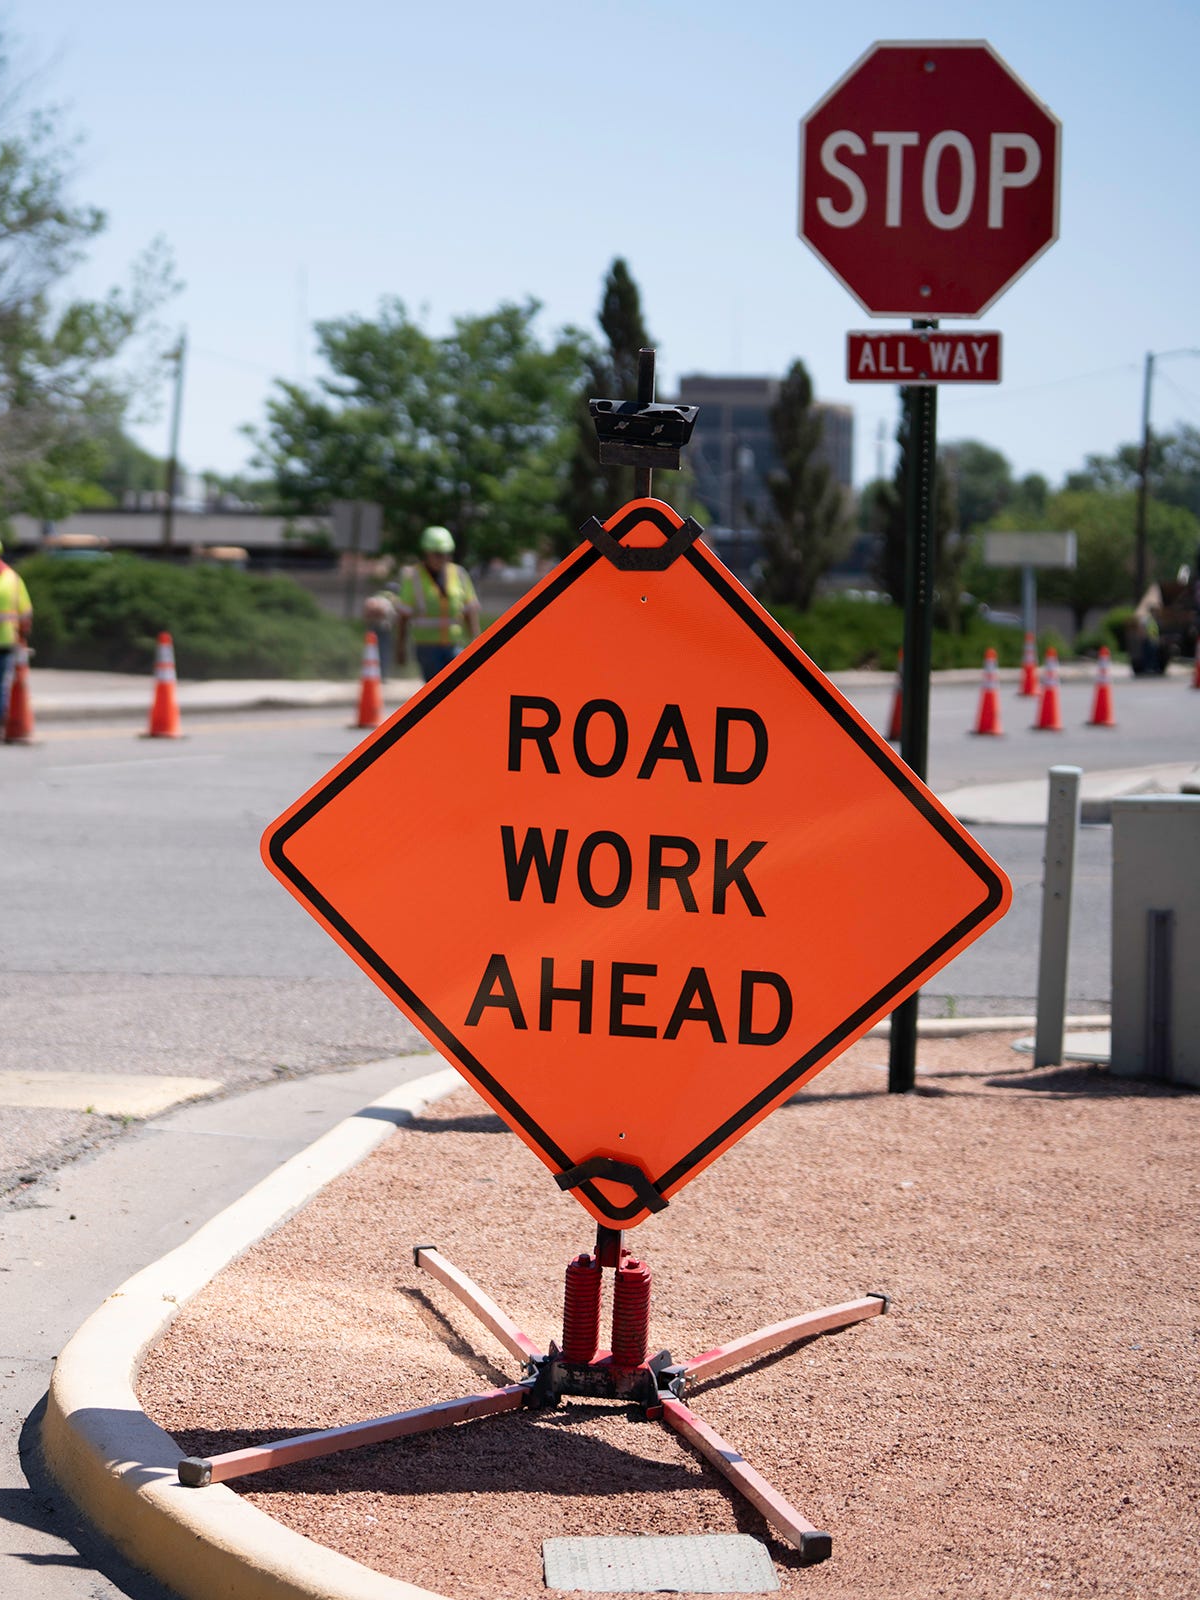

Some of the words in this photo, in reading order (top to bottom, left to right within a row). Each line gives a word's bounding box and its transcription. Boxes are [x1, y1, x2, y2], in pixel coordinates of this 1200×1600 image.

[817, 130, 1041, 229] STOP
[858, 342, 914, 372] ALL
[929, 342, 989, 372] WAY
[507, 695, 768, 784] ROAD
[500, 826, 767, 917] WORK
[464, 954, 792, 1046] AHEAD
